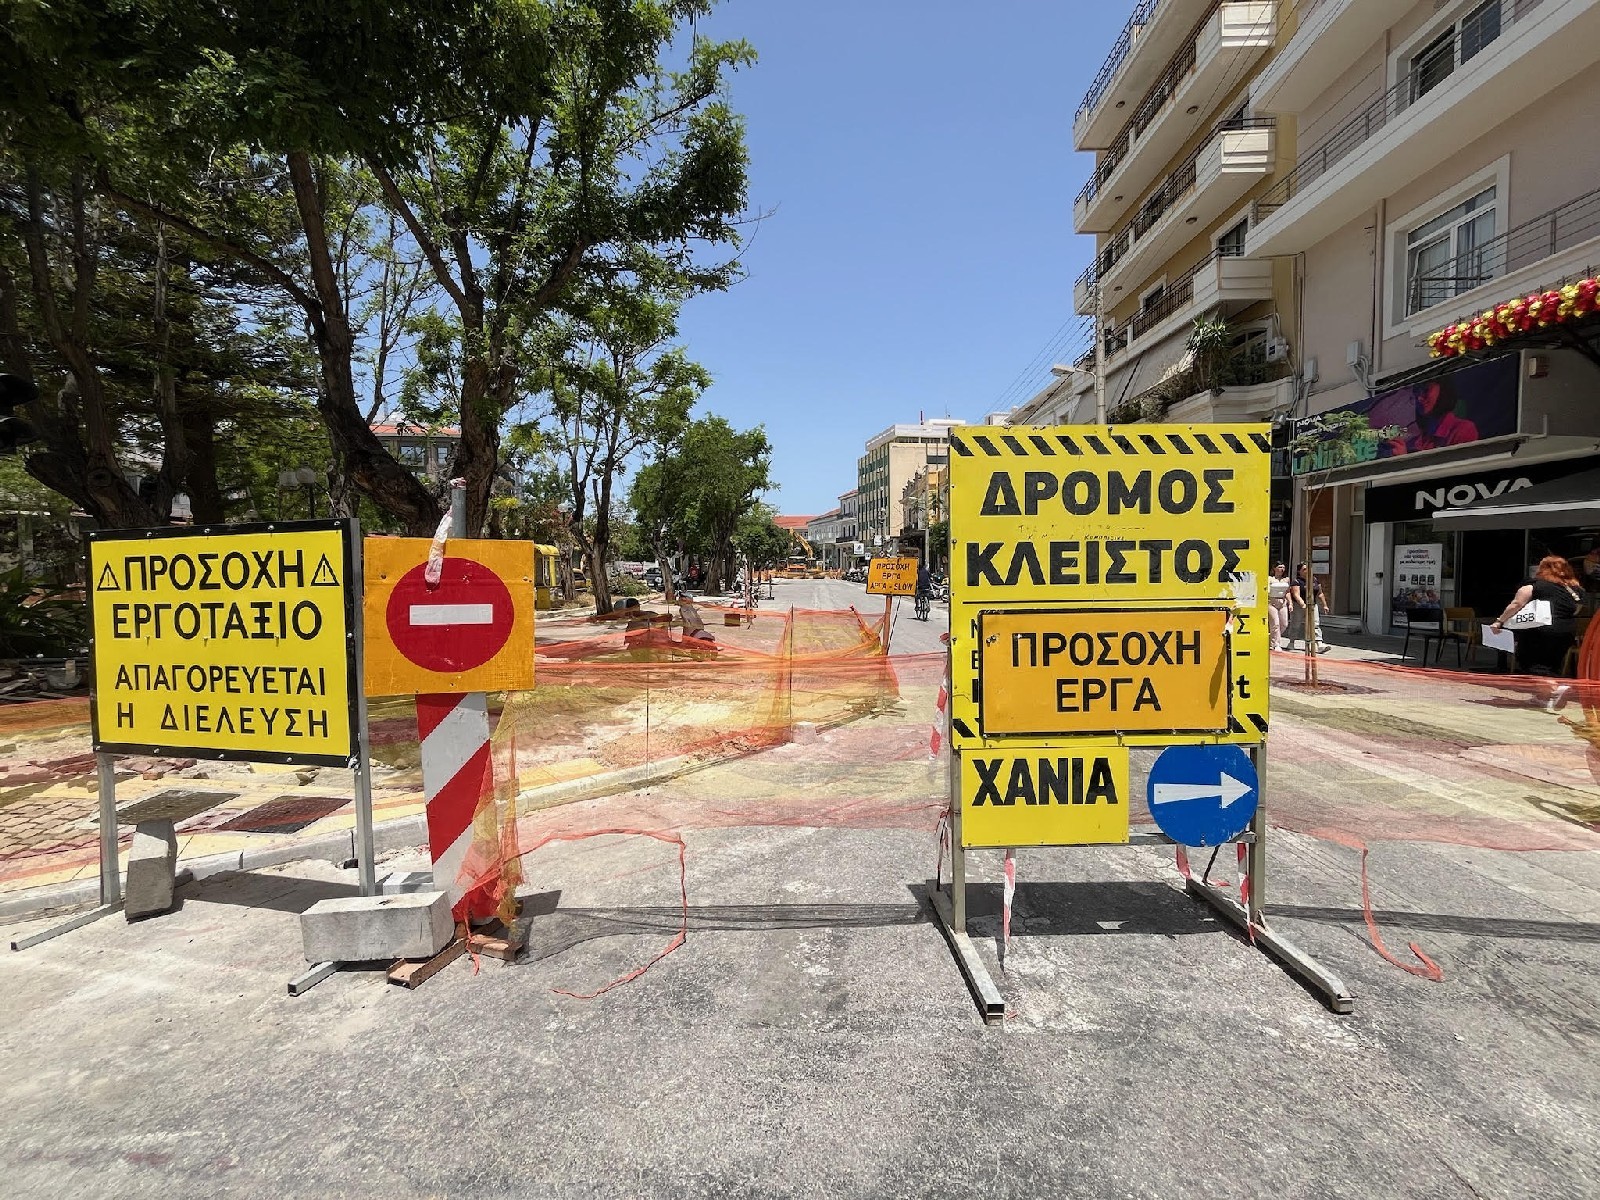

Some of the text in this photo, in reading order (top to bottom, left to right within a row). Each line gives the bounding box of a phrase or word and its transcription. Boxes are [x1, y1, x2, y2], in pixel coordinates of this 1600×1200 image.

[980, 469, 1235, 516] ΔΡΟΜΟΣ
[125, 549, 304, 592] ΠΡΟΣΟΧΗ
[882, 572, 901, 580] ΕΡΓΑ
[966, 539, 1250, 587] ΚΛΕΙΣΤΟΣ
[894, 582, 913, 591] SLOW
[113, 600, 323, 641] ΕΡΓΟΤΑΞΙΟ
[1516, 612, 1535, 623] BSB
[1012, 630, 1201, 668] ΠΡΟΣΟΧΗ
[115, 664, 326, 696] ΑΠΑΓΟΡΕΥΕΤΑΙ
[1056, 677, 1162, 713] ΕΡΓΑ
[117, 702, 328, 738] Η ΔΙΕΛΕΥΣΗ
[972, 757, 1119, 807] ΧΑΝΙΑ
